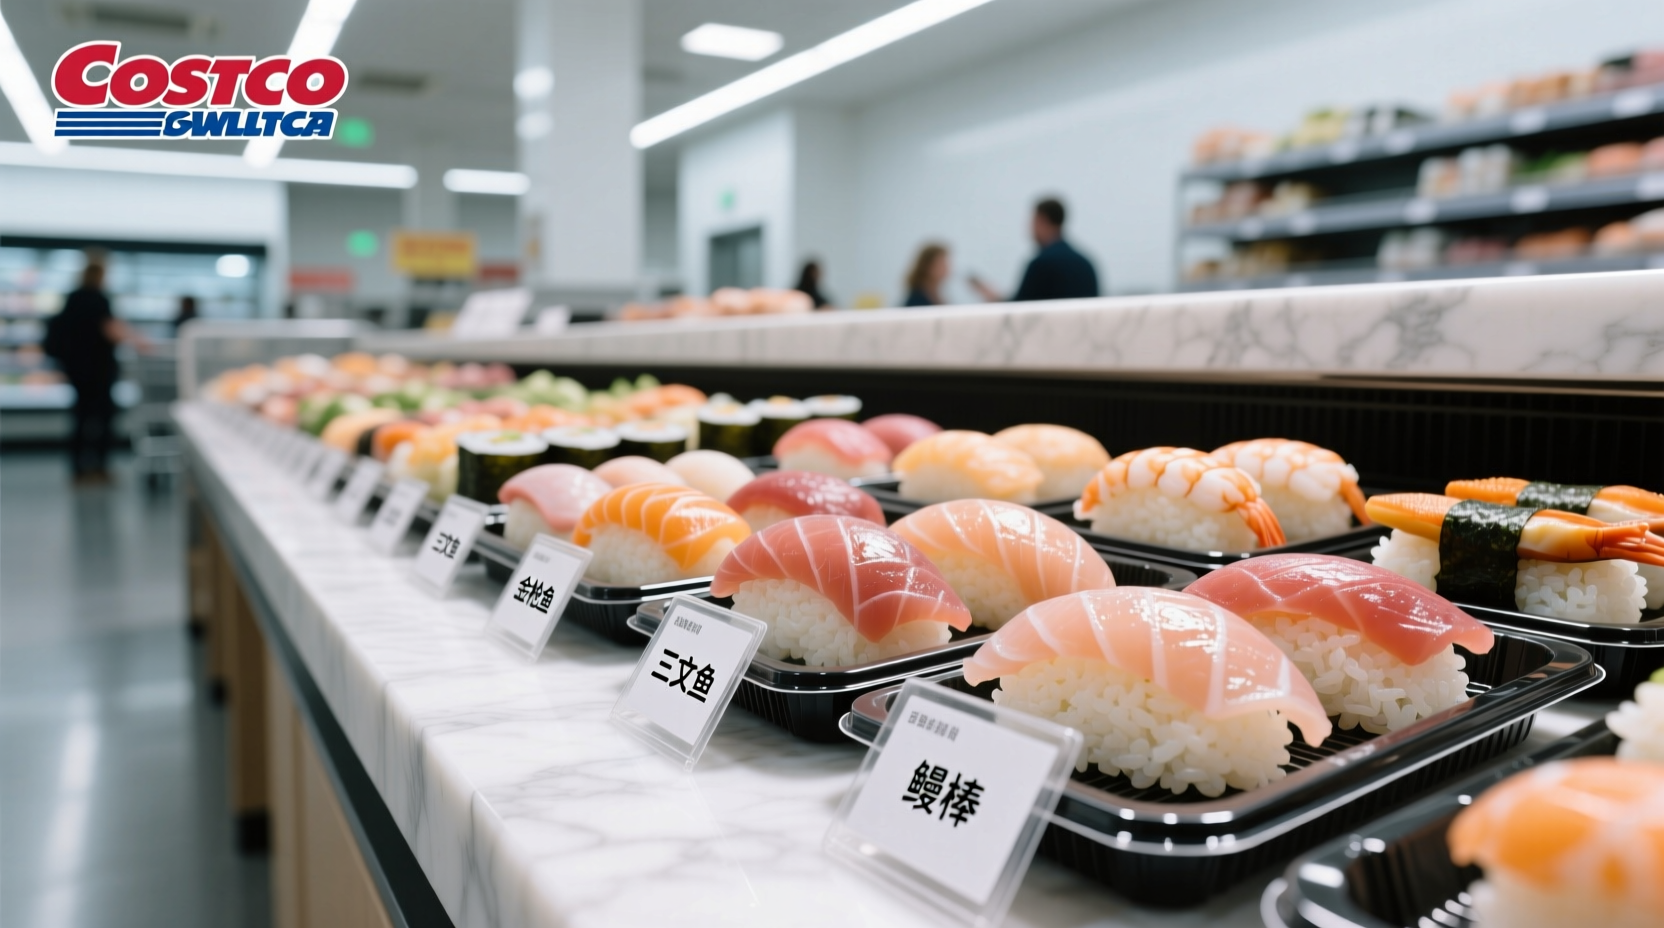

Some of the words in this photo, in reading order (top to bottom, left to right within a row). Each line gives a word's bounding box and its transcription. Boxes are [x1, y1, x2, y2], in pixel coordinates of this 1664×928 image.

[651, 648, 715, 703] 三文鱼
[901, 759, 985, 828] 鳗棒
